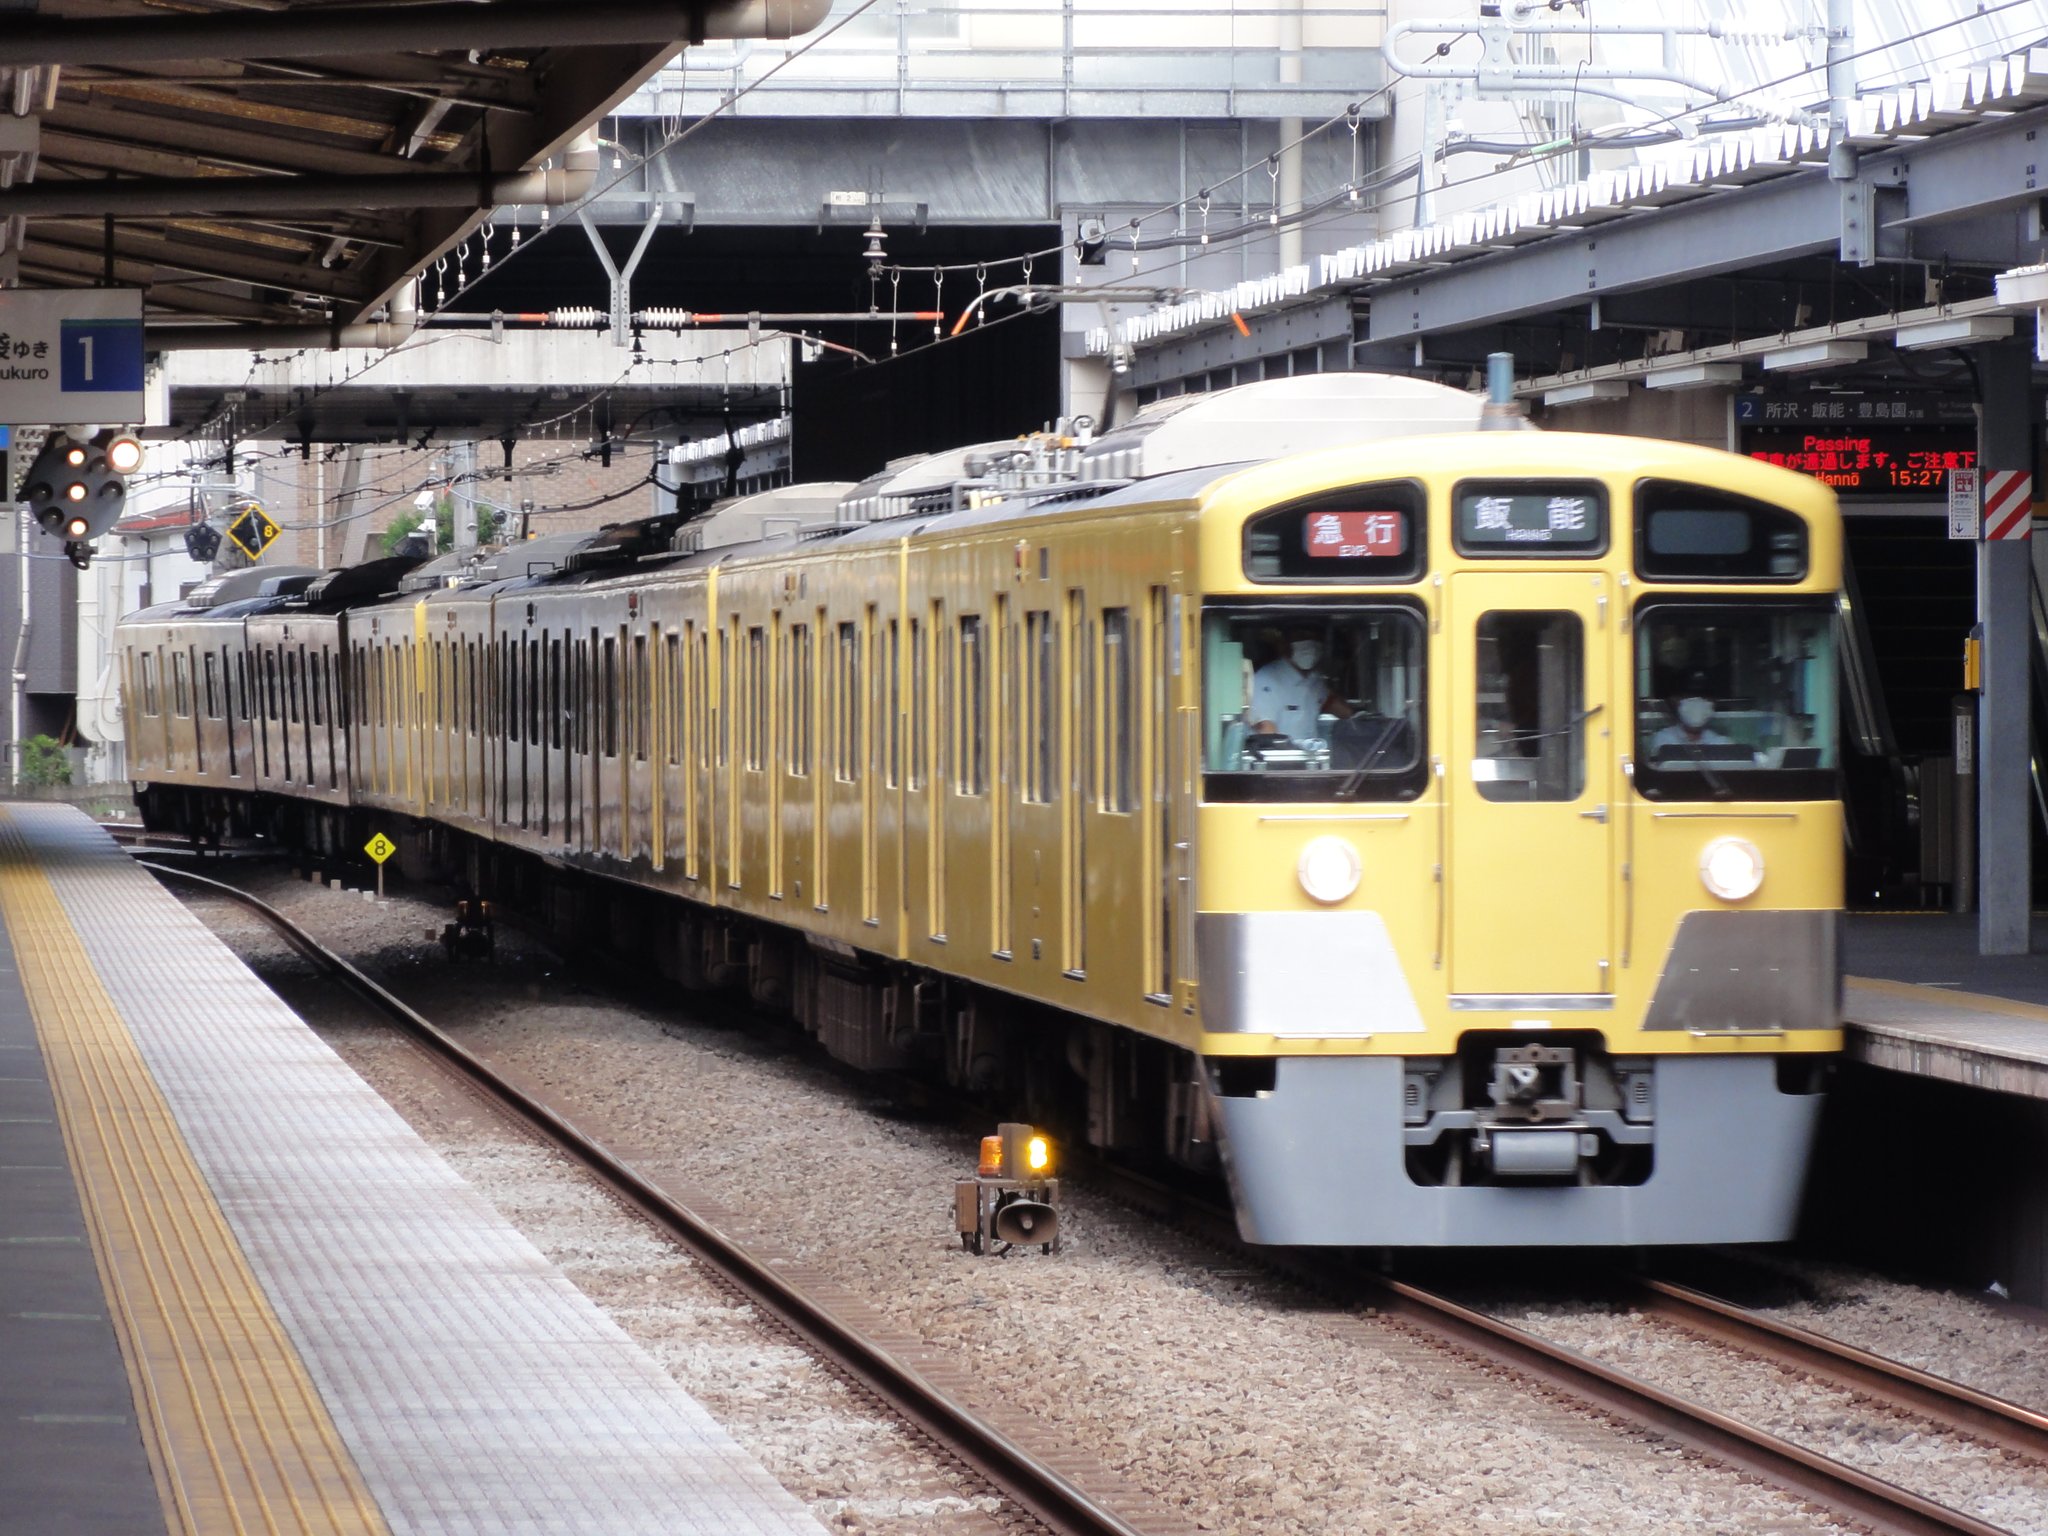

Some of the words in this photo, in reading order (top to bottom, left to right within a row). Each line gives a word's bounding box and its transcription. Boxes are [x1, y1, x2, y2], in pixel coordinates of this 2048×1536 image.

[78, 335, 94, 381] 1
[1742, 401, 1753, 418] 2
[1803, 435, 1871, 453] Passing
[1890, 470, 1943, 486] 15:27
[264, 525, 273, 538] 8
[1312, 514, 1396, 545] 急行
[374, 839, 387, 856] 8
